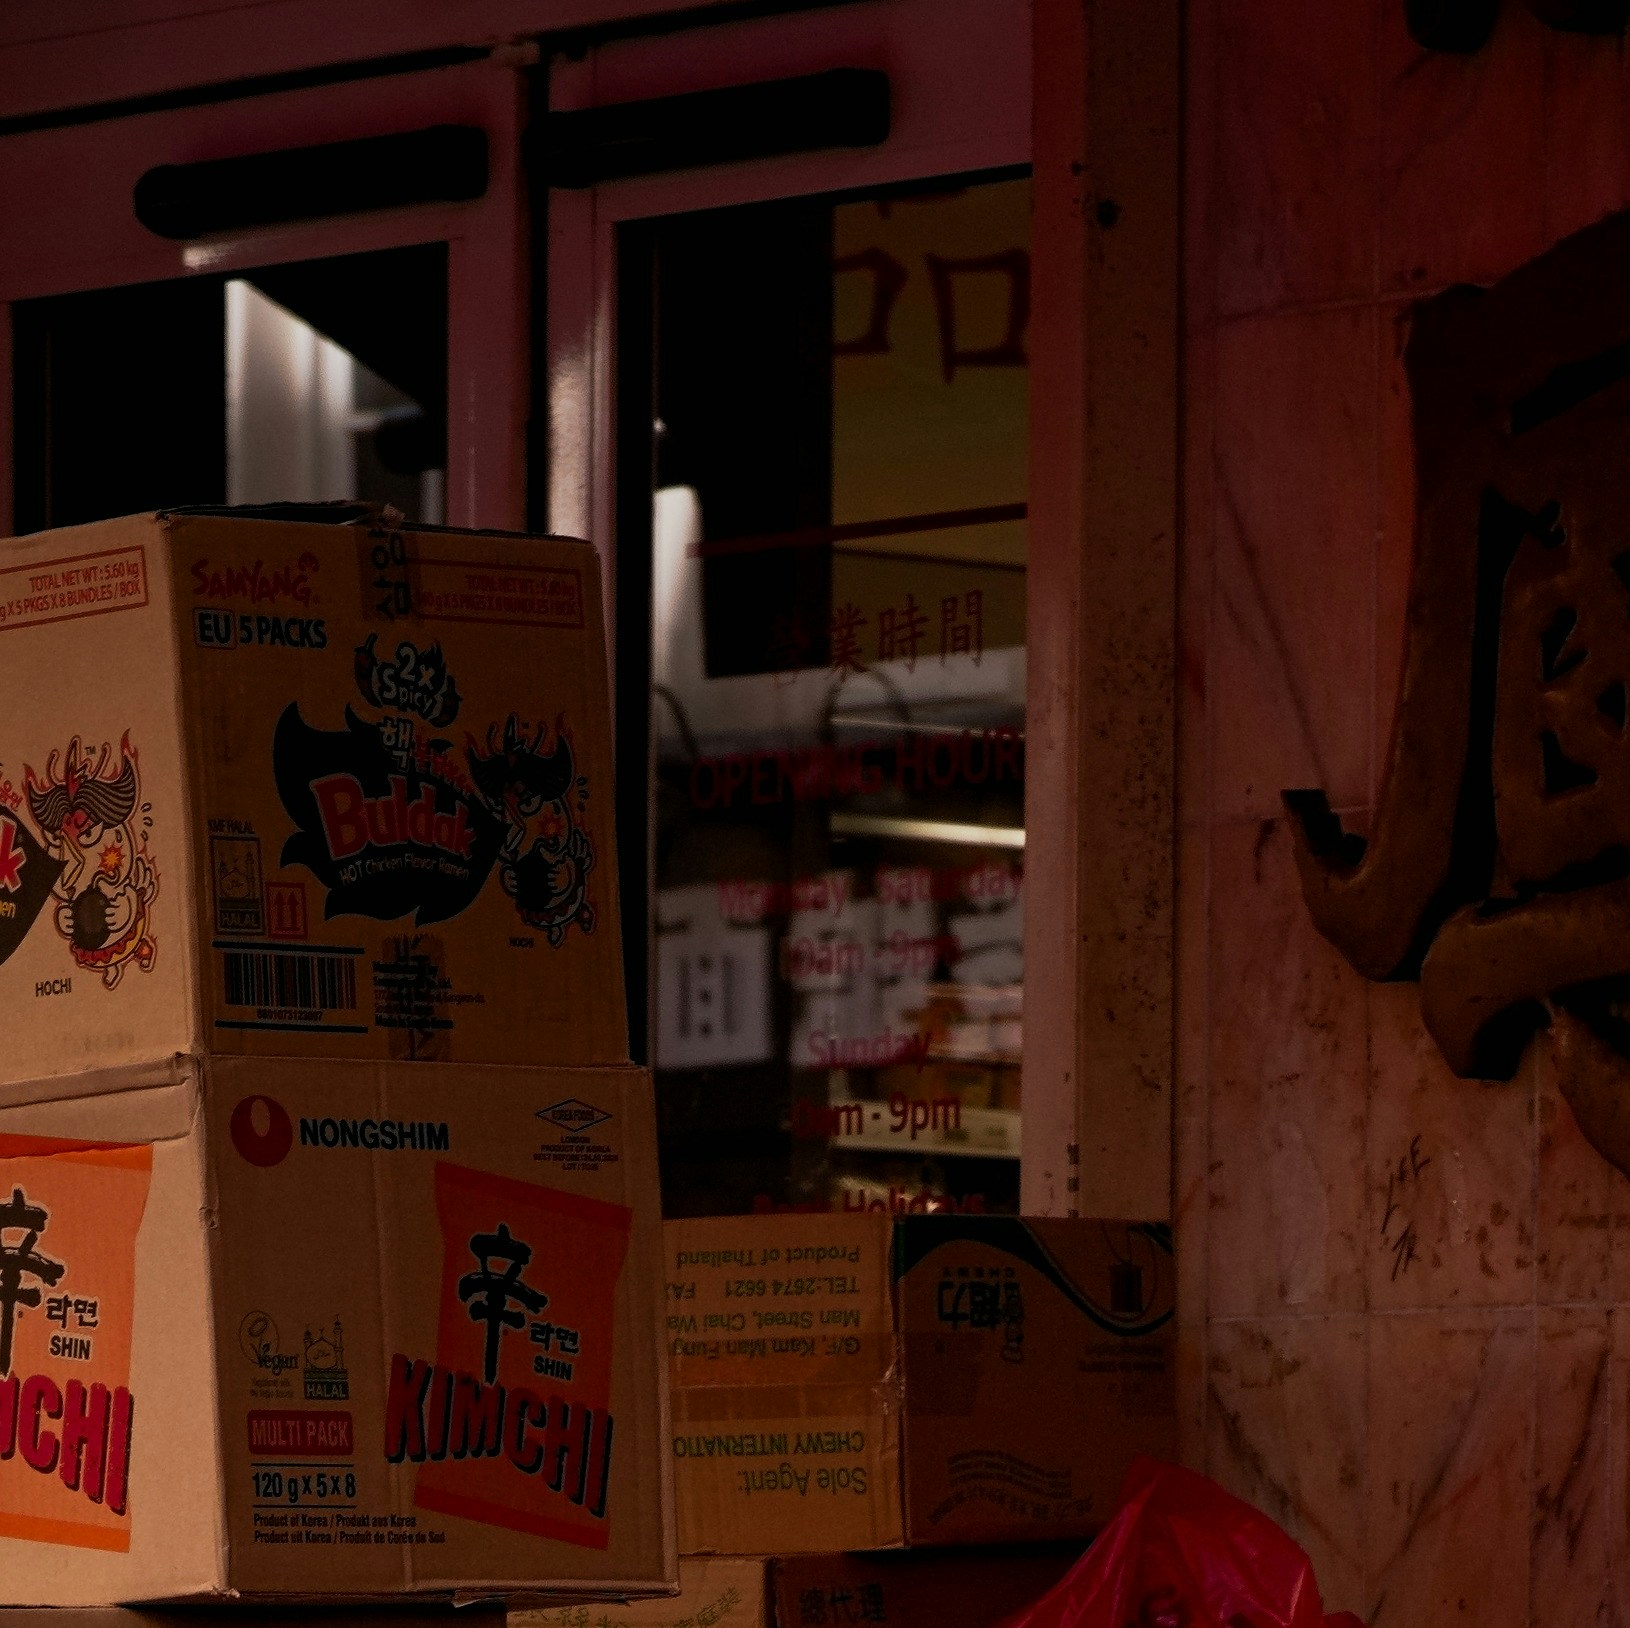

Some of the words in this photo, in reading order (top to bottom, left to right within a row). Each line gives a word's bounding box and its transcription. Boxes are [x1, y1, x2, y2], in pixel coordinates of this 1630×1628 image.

[199, 612, 231, 644] EU
[240, 614, 252, 644] 5
[256, 616, 327, 649] PACKS
[688, 741, 885, 810] OPENING
[310, 773, 477, 860] Buldak
[35, 978, 71, 998] HOCHI
[806, 1026, 932, 1075] Sunday
[299, 1117, 450, 1150] NONGSHIM
[677, 1250, 757, 1269] Thailand
[761, 1250, 778, 1266] of
[786, 1247, 861, 1264] Product
[45, 1295, 99, 1330] 라면
[458, 1223, 548, 1383] 辛
[50, 1335, 91, 1360] SHIN
[530, 1322, 579, 1354] 라면
[533, 1355, 572, 1381] SHIN
[305, 1382, 346, 1399] HALAL
[251, 1420, 299, 1447] MULTI
[306, 1420, 349, 1448] PACK
[385, 1353, 613, 1519] KIMCHI
[252, 1474, 283, 1498] 120
[316, 1474, 327, 1498] 5
[345, 1475, 356, 1498] 8
[737, 1463, 811, 1496] Agent:
[816, 1467, 867, 1495] Sole
[254, 1514, 288, 1528] Product
[291, 1514, 300, 1527] of
[301, 1514, 327, 1528] Korea
[336, 1514, 369, 1528] Produkt
[390, 1514, 416, 1528] Korea
